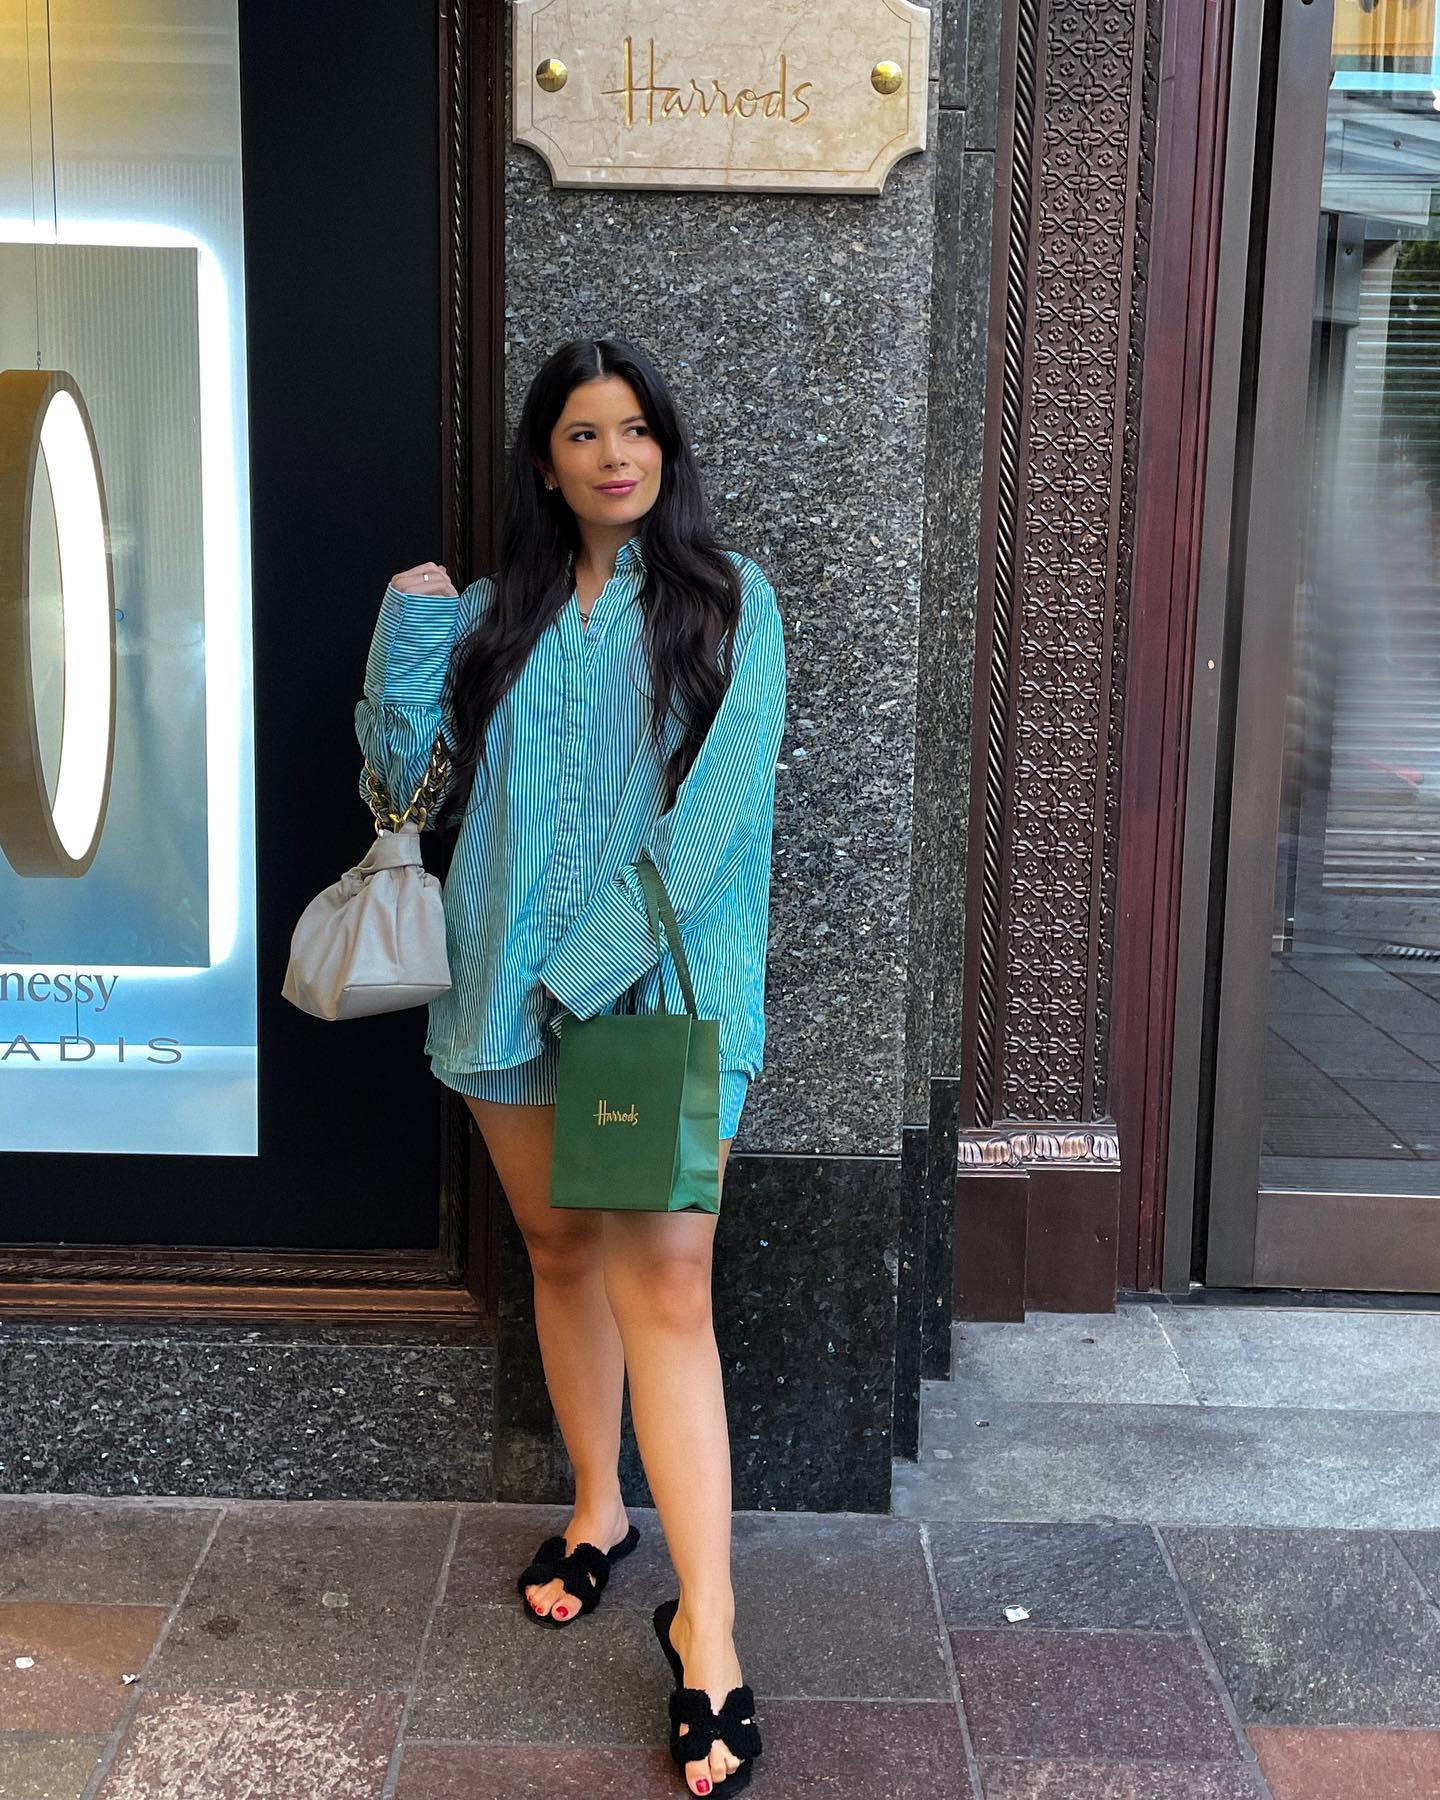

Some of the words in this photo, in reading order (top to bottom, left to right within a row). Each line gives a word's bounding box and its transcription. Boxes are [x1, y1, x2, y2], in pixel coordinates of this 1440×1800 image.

[601, 35, 813, 126] Harrods
[1, 1034, 182, 1064] ADIS
[593, 1099, 639, 1126] Harrods
